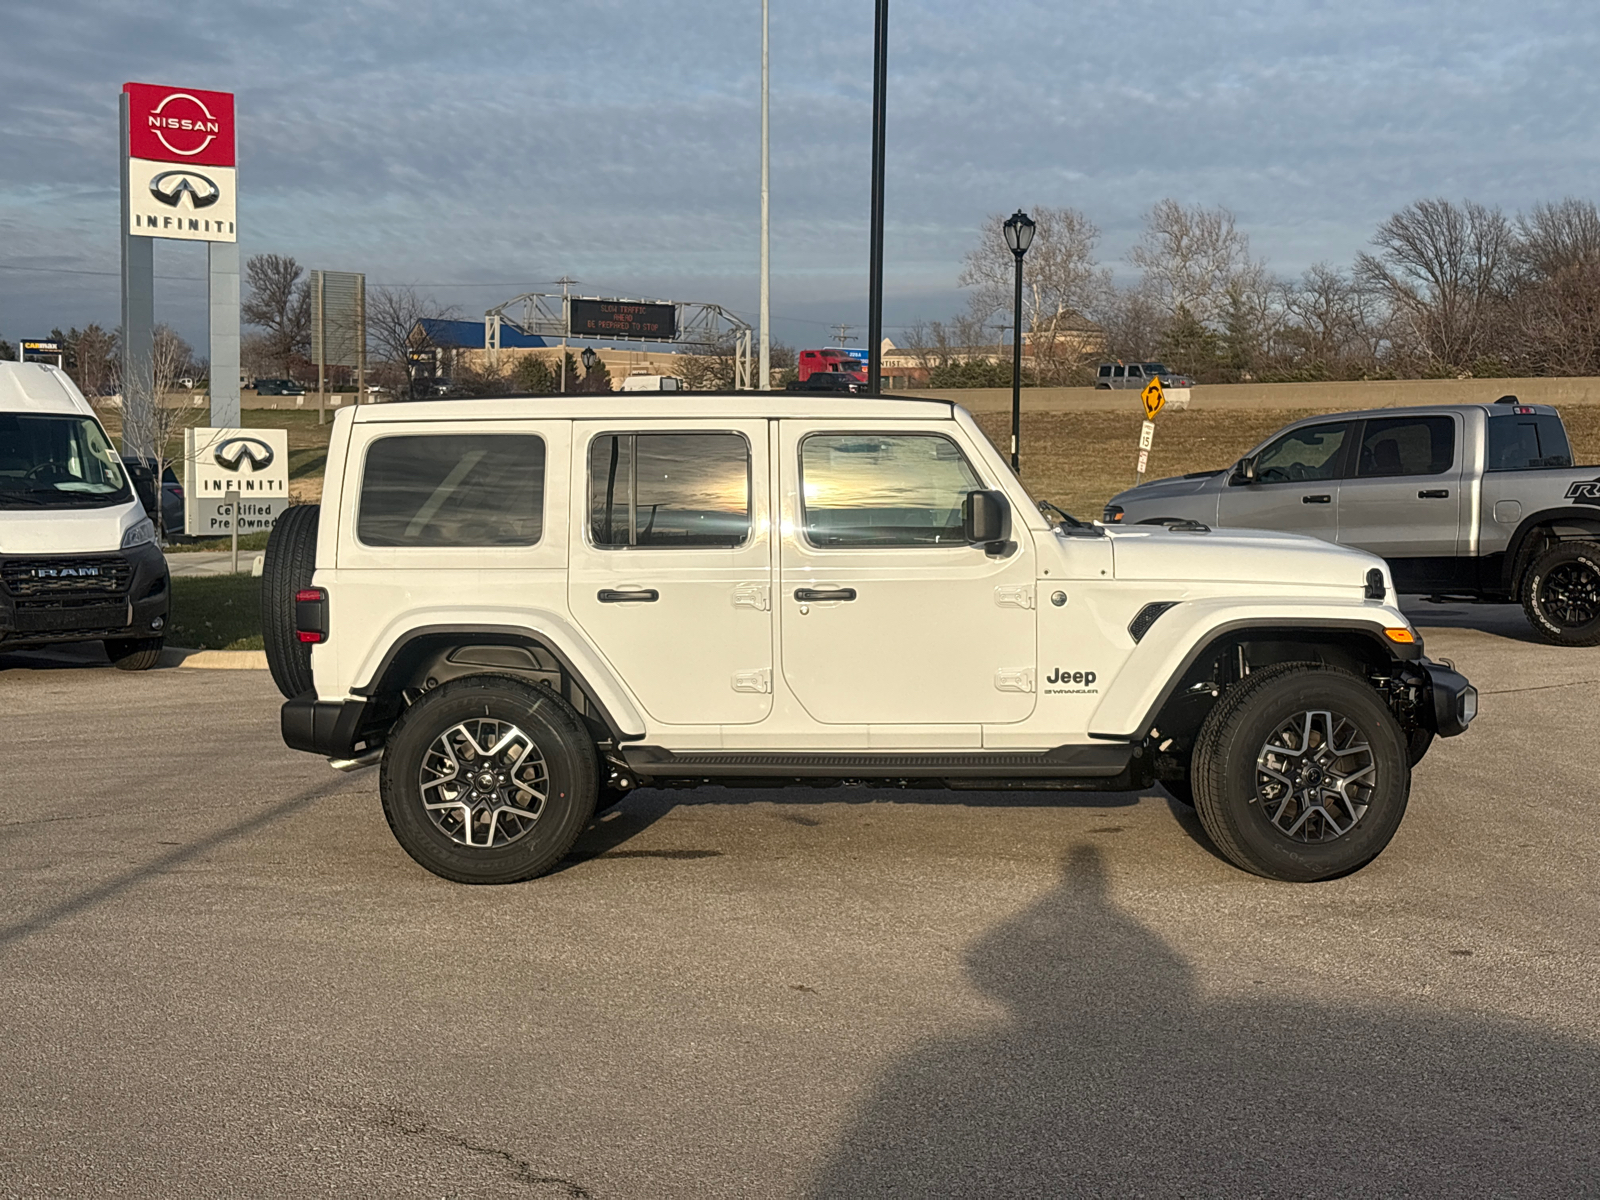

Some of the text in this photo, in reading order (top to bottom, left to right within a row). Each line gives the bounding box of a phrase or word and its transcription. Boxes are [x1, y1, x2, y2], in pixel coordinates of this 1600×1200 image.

[148, 115, 219, 133] NISSAN
[135, 214, 234, 234] INFINITI
[600, 304, 647, 314] SLOW TRAFFIC
[613, 314, 633, 322] AHEAD
[587, 320, 596, 328] BE
[598, 321, 629, 330] PREPARED
[643, 323, 659, 331] STOP
[1142, 436, 1150, 447] 15
[204, 479, 283, 491] INFINITI
[216, 504, 271, 516] Cetified
[38, 567, 99, 577] RAM
[1046, 667, 1097, 687] Jeep
